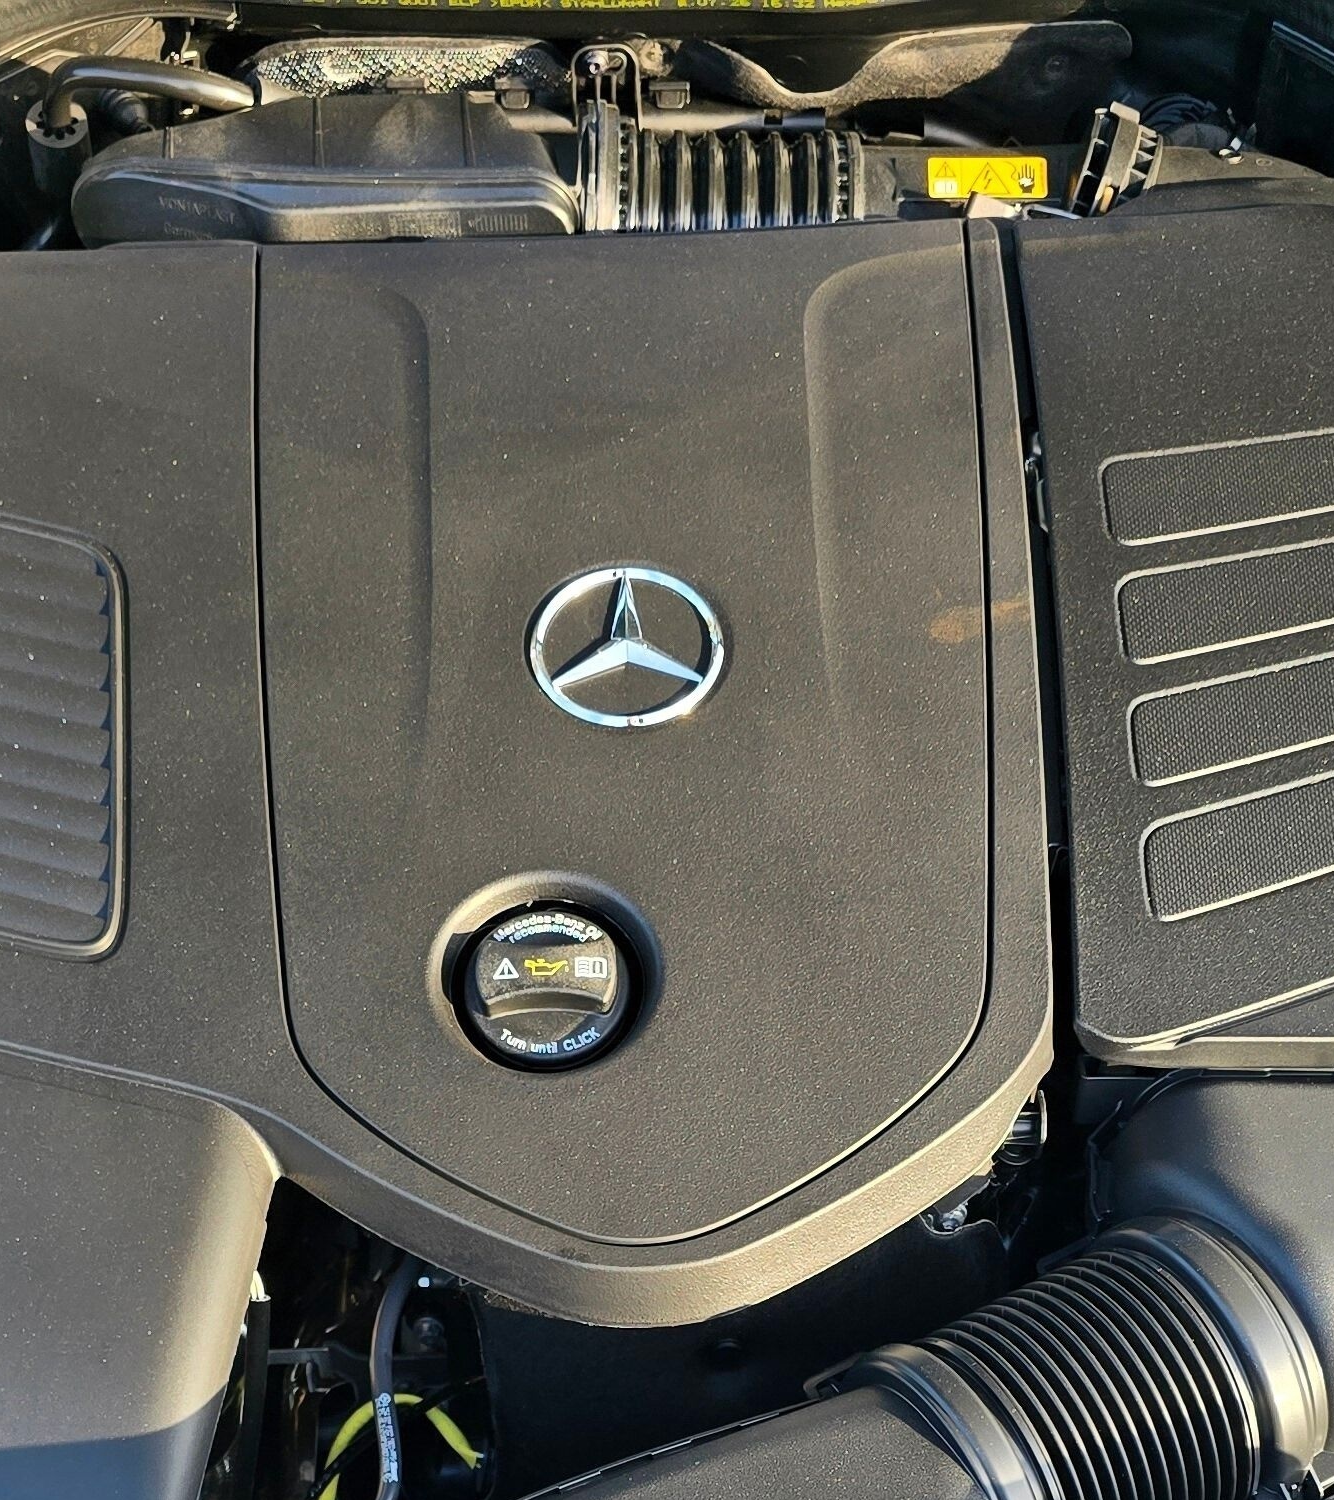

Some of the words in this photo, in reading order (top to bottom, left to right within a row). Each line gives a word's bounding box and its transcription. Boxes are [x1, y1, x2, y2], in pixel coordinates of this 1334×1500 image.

[492, 913, 587, 942] Mercedes-Benz
[508, 923, 590, 944] recommended
[499, 1028, 528, 1051] Turn
[530, 1041, 558, 1054] until
[563, 1026, 602, 1052] CLICK
